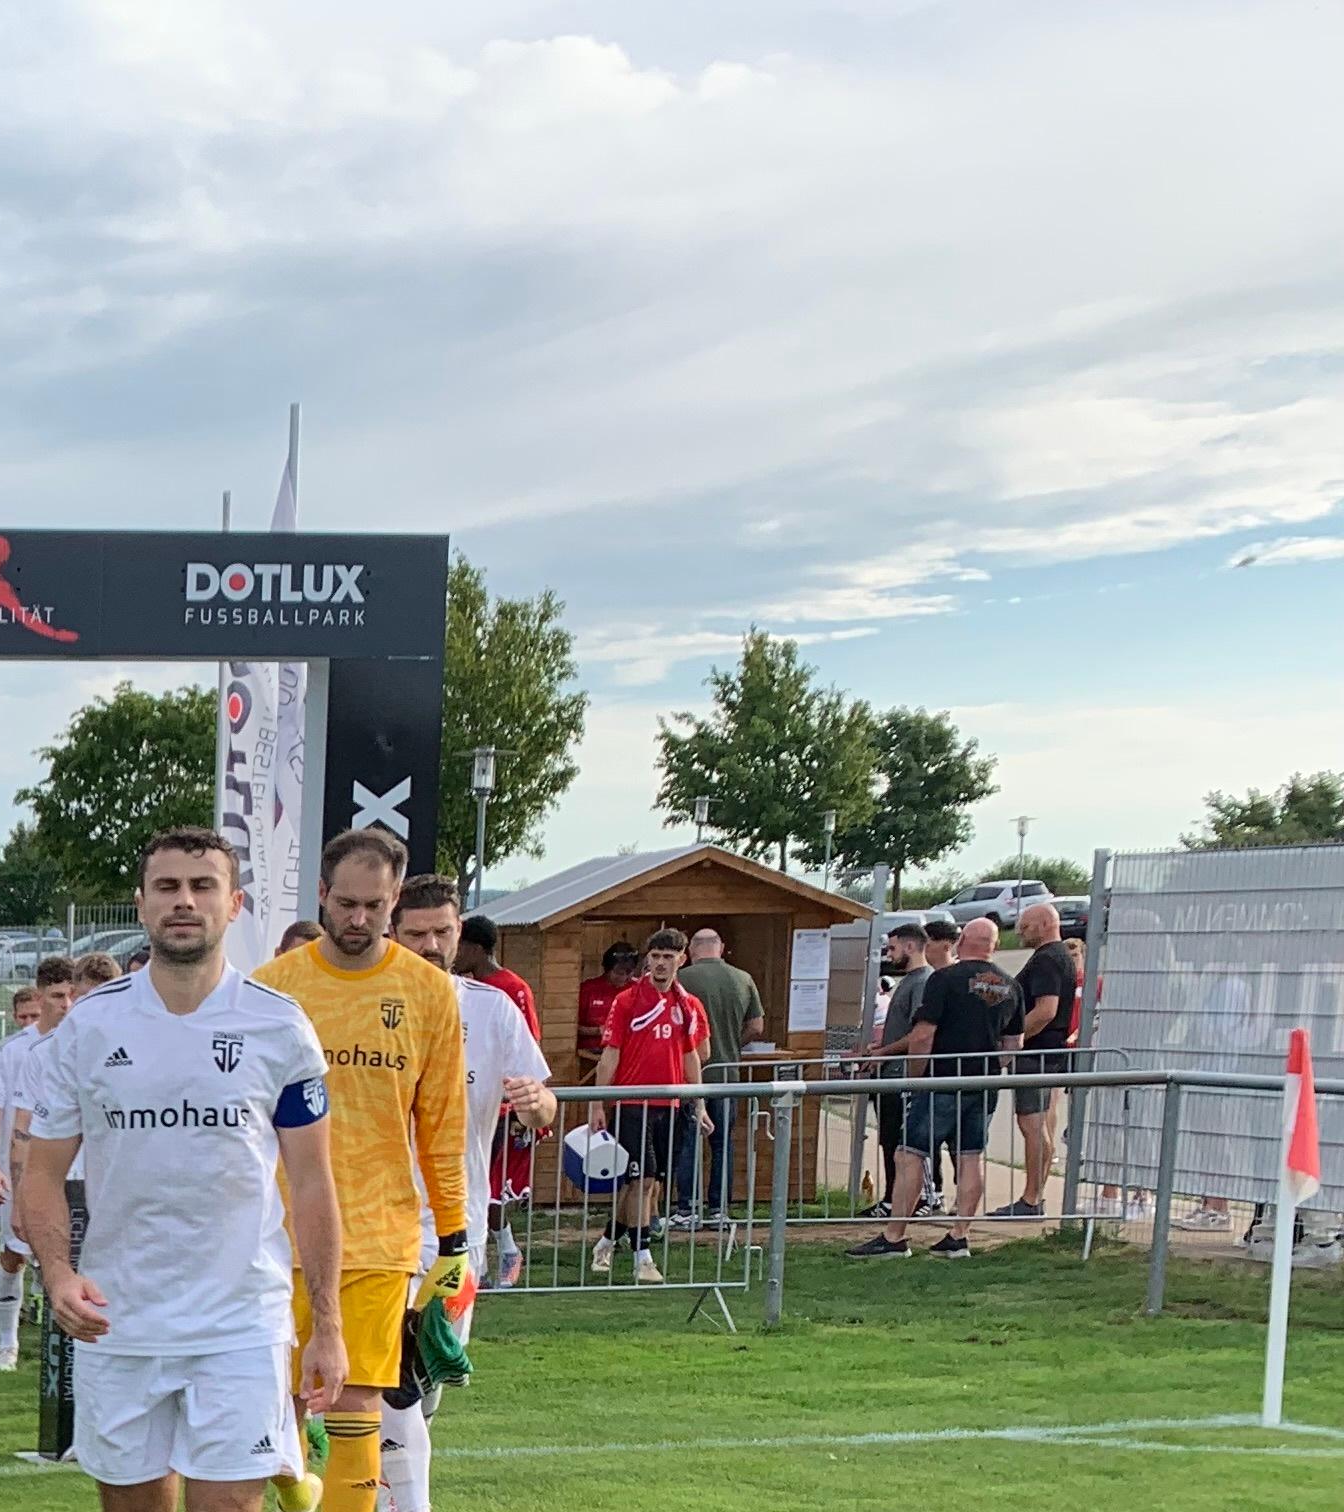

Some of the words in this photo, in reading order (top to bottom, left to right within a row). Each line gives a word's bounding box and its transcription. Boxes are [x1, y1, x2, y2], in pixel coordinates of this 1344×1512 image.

[185, 562, 365, 603] DOTLUX
[184, 608, 365, 626] FUSSBALLPARK
[652, 1023, 672, 1039] 19
[102, 1100, 250, 1129] immohaus
